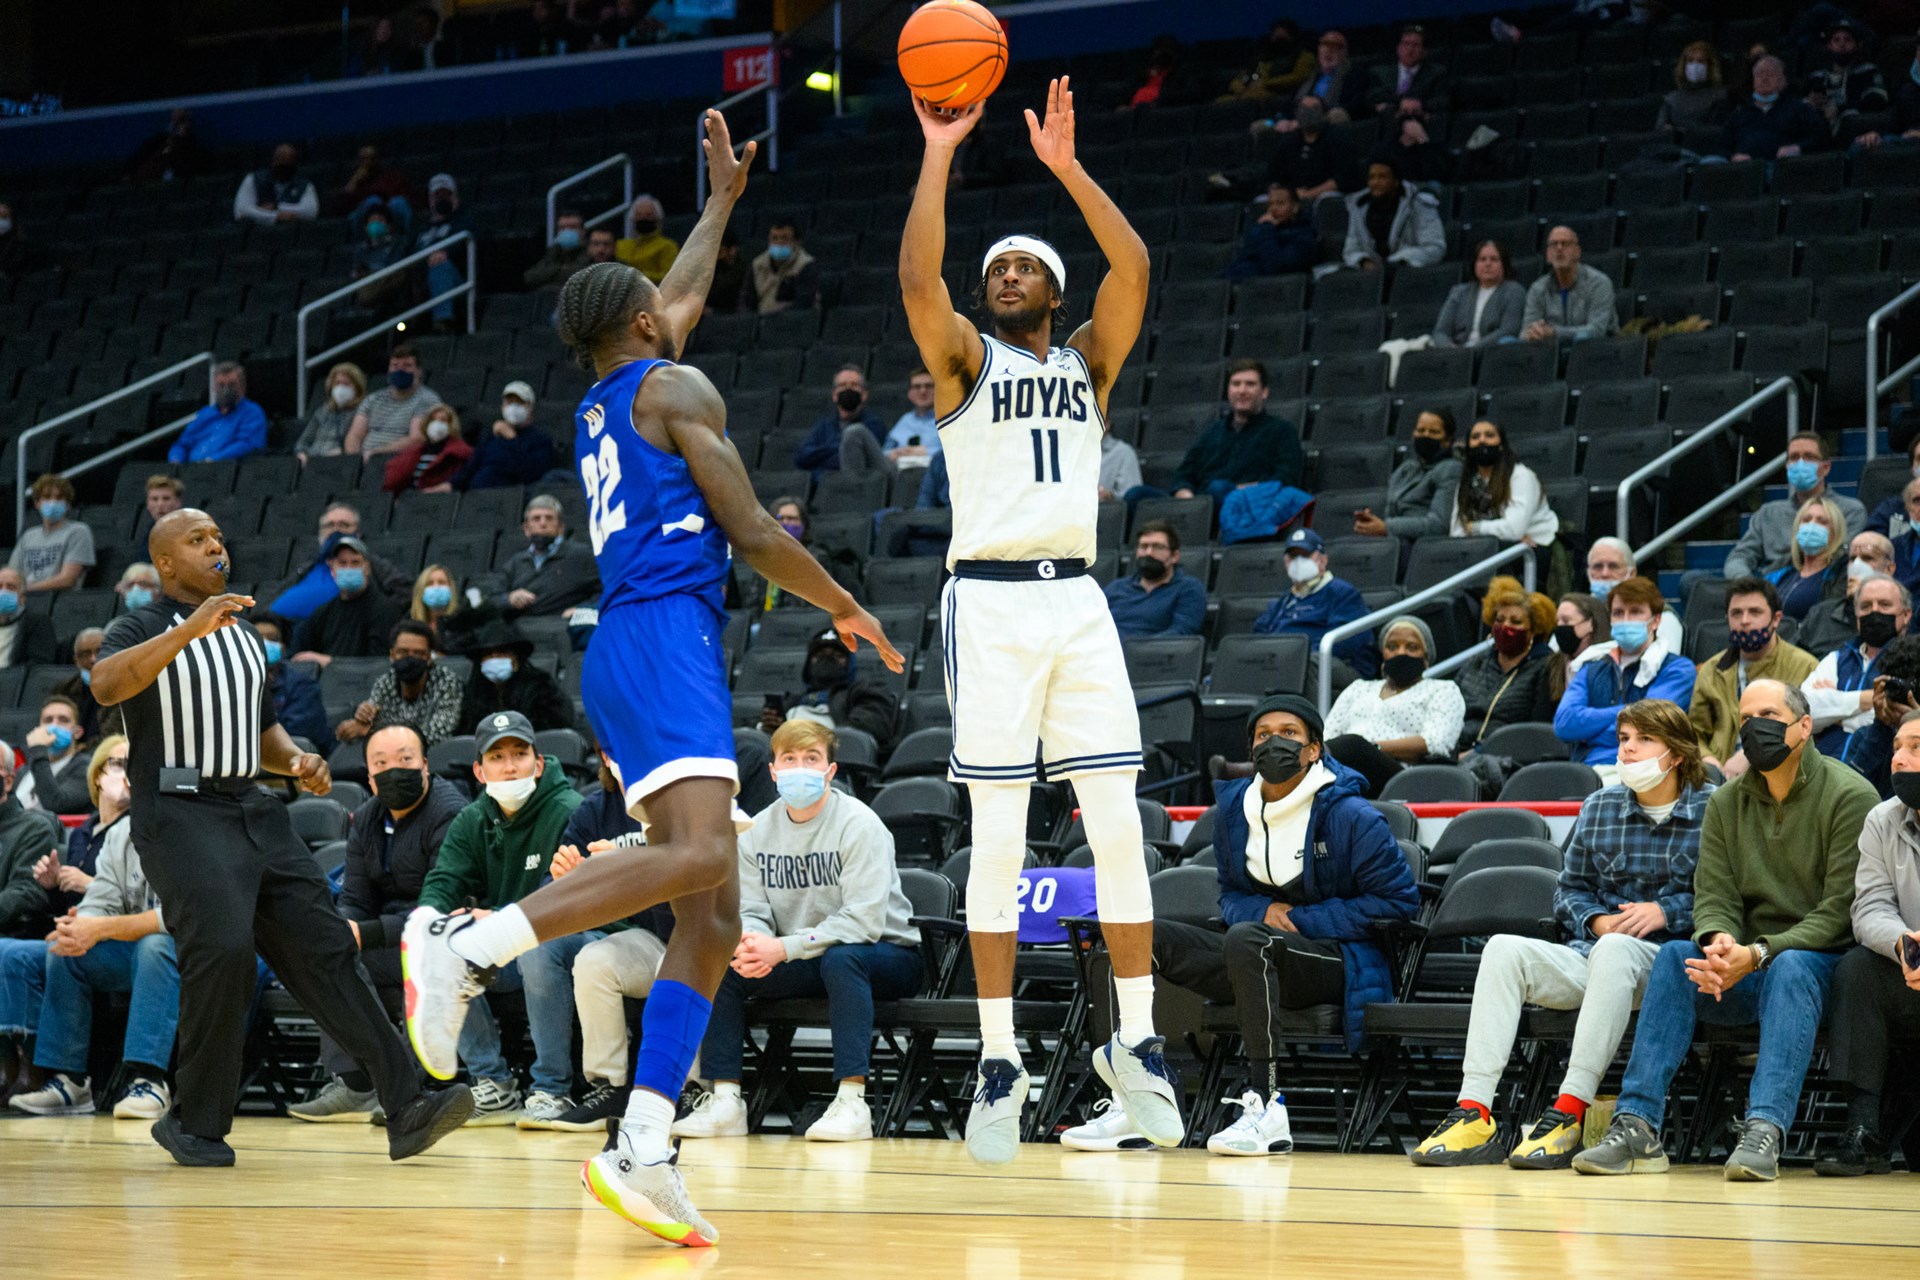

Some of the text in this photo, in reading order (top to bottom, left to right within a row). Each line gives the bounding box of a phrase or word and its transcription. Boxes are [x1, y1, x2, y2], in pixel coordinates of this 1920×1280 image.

[991, 377, 1087, 423] HOYAS
[1031, 428, 1061, 482] 11
[580, 433, 626, 557] 22
[1037, 560, 1056, 579] G
[1016, 877, 1058, 913] 20
